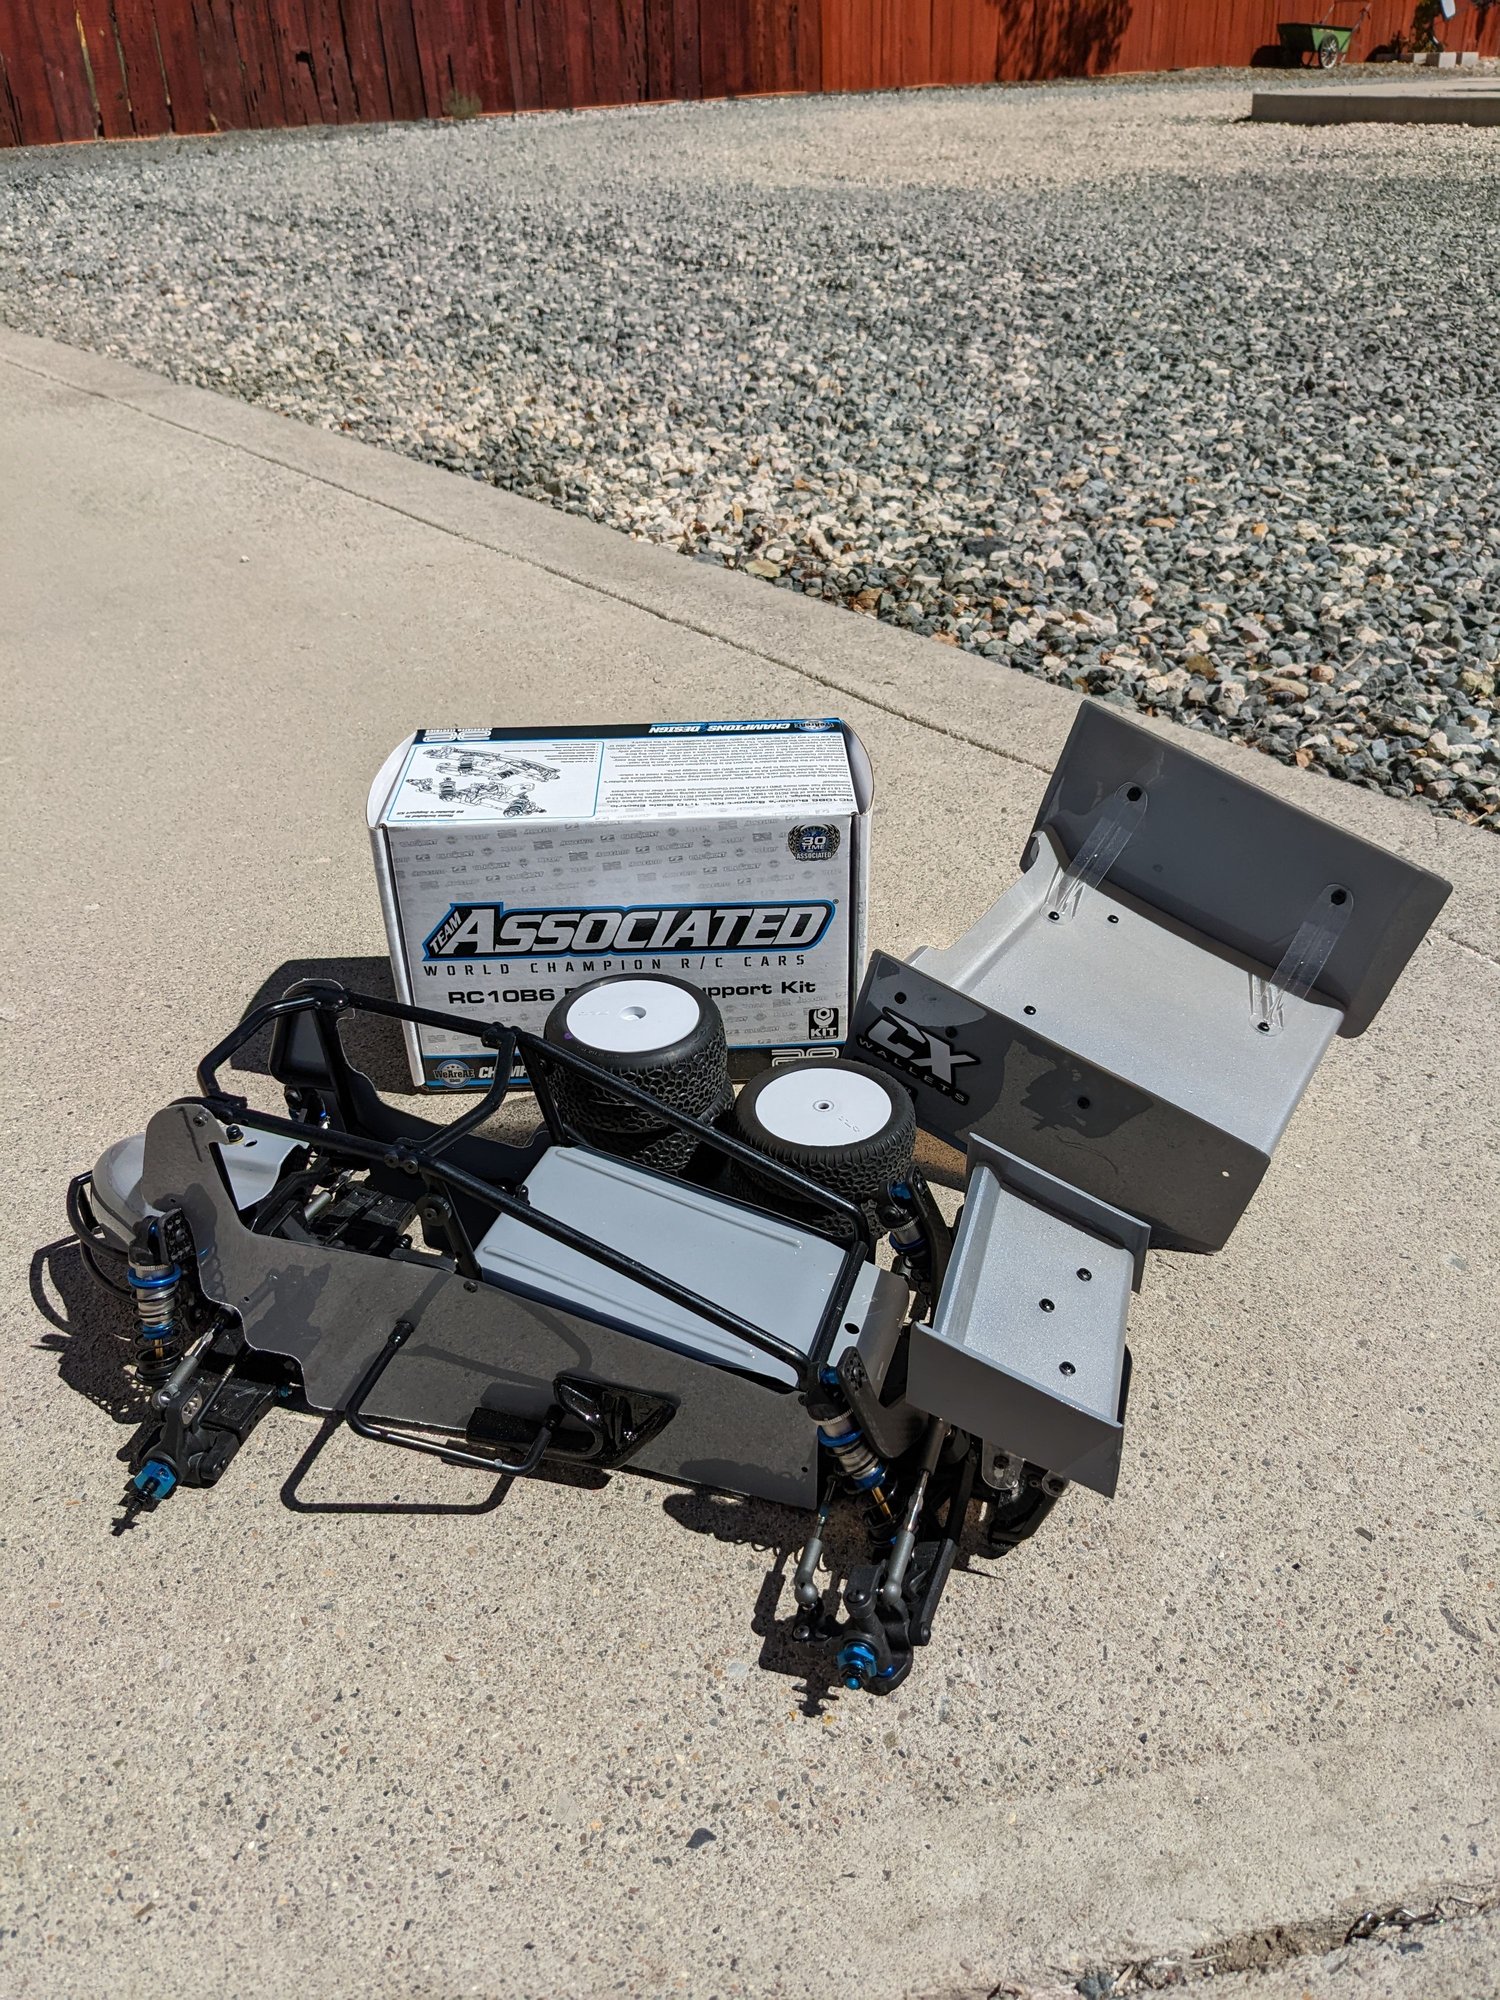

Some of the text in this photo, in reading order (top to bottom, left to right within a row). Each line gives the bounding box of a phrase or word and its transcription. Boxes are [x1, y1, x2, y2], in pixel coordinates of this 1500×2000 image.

[649, 726, 701, 734] DESIGN
[707, 723, 791, 731] CHAMPIONS
[802, 836, 827, 846] 30
[797, 852, 832, 860] ASSOCIATED
[429, 910, 462, 954] TEAM
[438, 906, 828, 955] ASSOCIATED
[424, 954, 805, 976] WORLD CHAMPION R/C CARS
[448, 988, 556, 1004] RC10B6
[781, 980, 816, 994] Kit
[810, 1028, 836, 1037] KIT
[433, 1069, 476, 1078] WeAreAE
[858, 1038, 966, 1102] WALLETS
